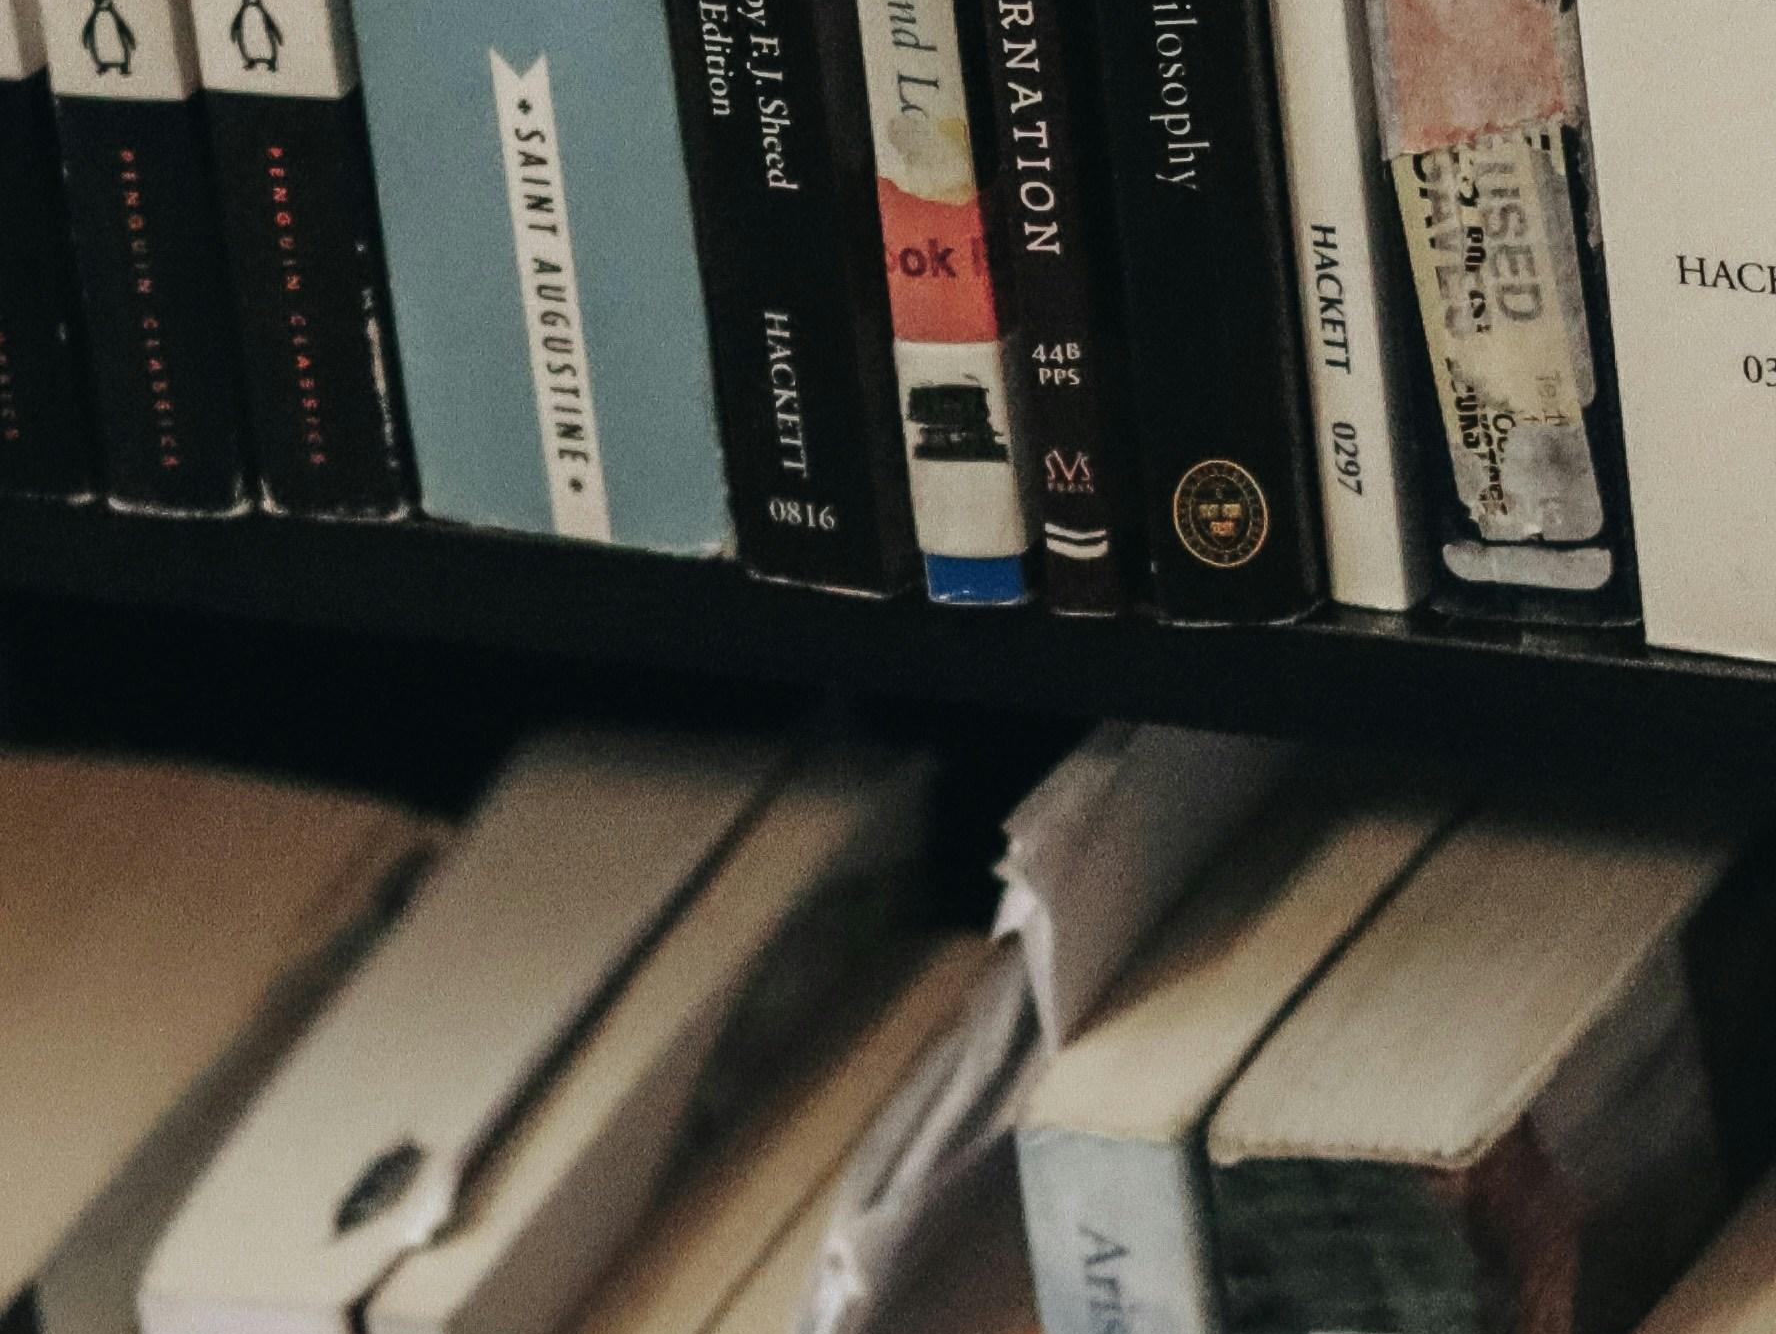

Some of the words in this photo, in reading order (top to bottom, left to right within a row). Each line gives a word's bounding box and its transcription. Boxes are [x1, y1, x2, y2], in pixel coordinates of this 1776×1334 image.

[749, 30, 784, 59] F.
[512, 129, 559, 237] SAINT
[757, 94, 802, 191] Sheed
[533, 257, 592, 464] AUGUSTINE
[763, 311, 807, 477] HACKETT
[1038, 366, 1081, 387] PPS
[1310, 223, 1351, 374] HACKETT
[1332, 421, 1363, 497] 0297
[769, 496, 836, 531] 0816
